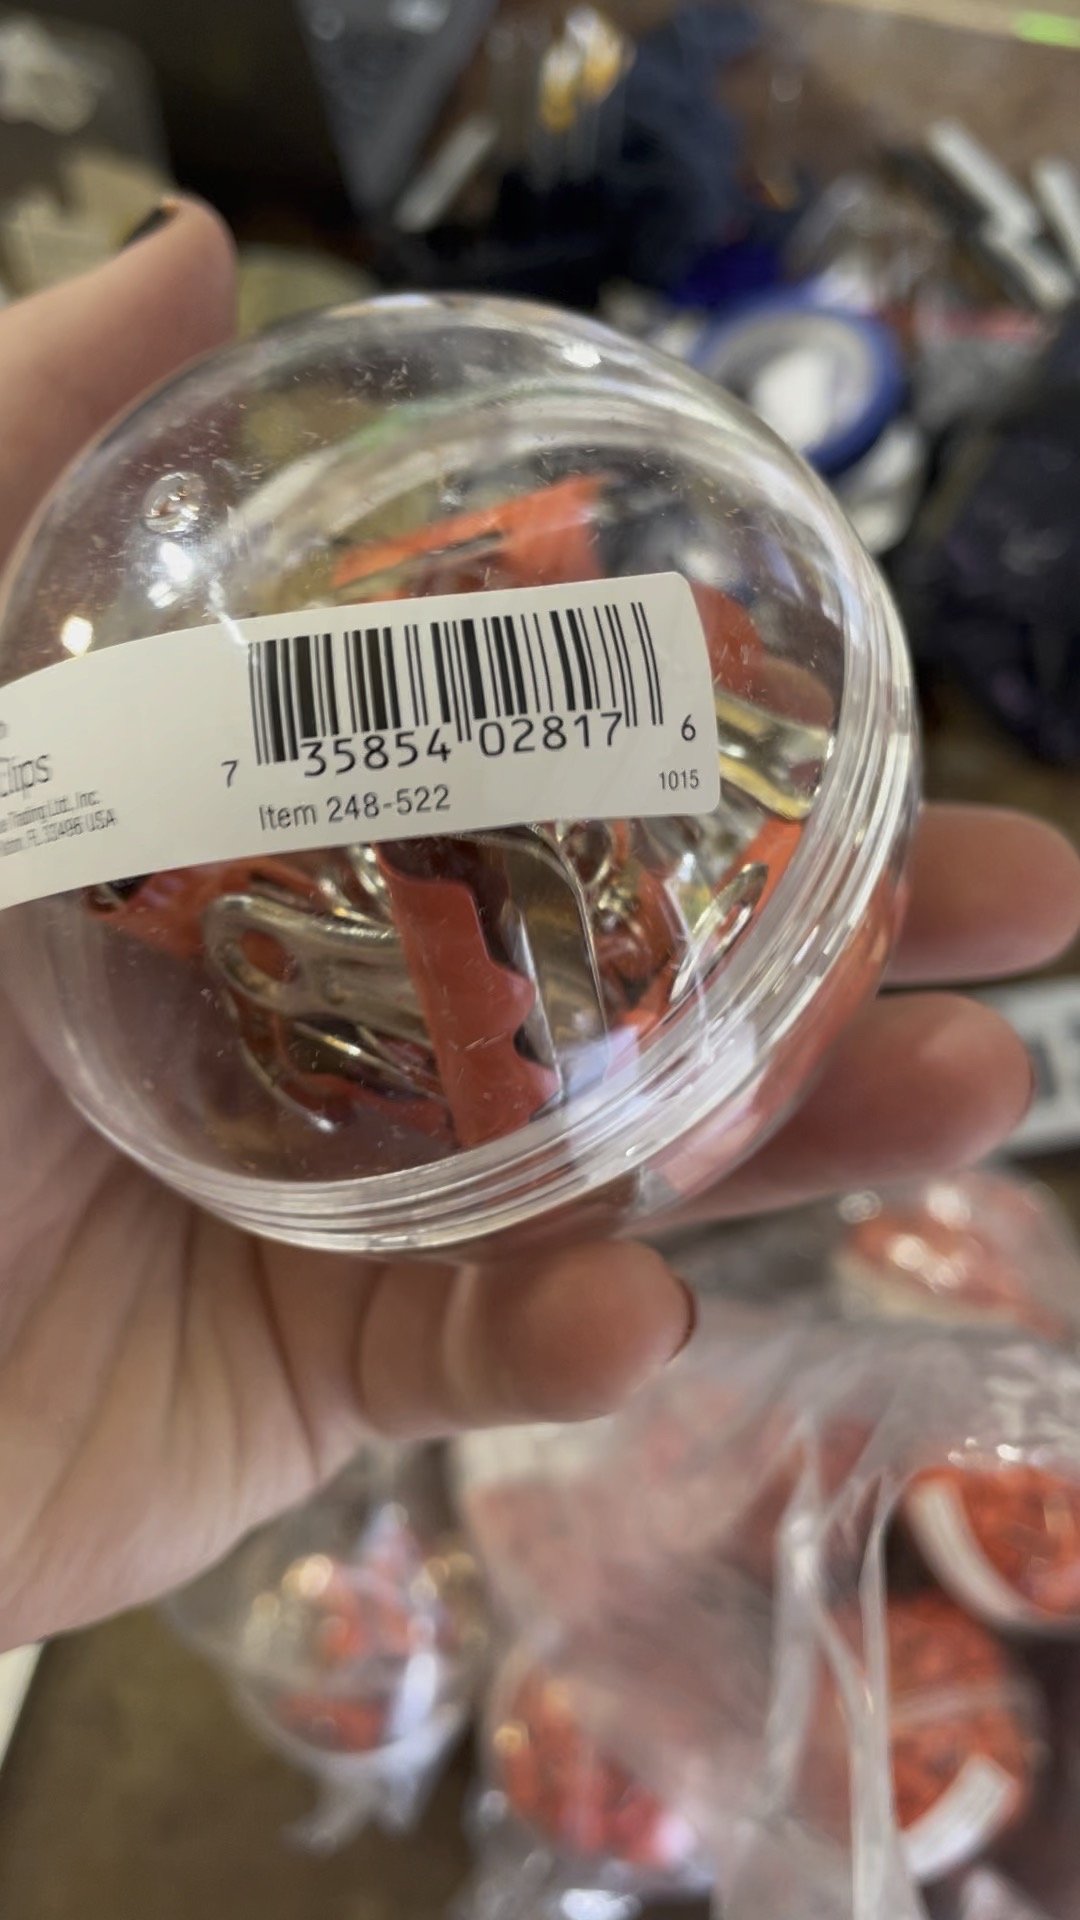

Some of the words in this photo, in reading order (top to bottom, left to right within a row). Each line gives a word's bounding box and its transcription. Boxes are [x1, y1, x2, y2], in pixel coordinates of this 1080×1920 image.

[221, 760, 240, 788] 7
[300, 727, 451, 777] 35854
[478, 711, 623, 757] 02817
[681, 714, 697, 741] 6
[658, 769, 700, 791] 1015
[85, 808, 117, 834] USA
[258, 803, 318, 831] Item
[326, 784, 451, 824] 248-522
